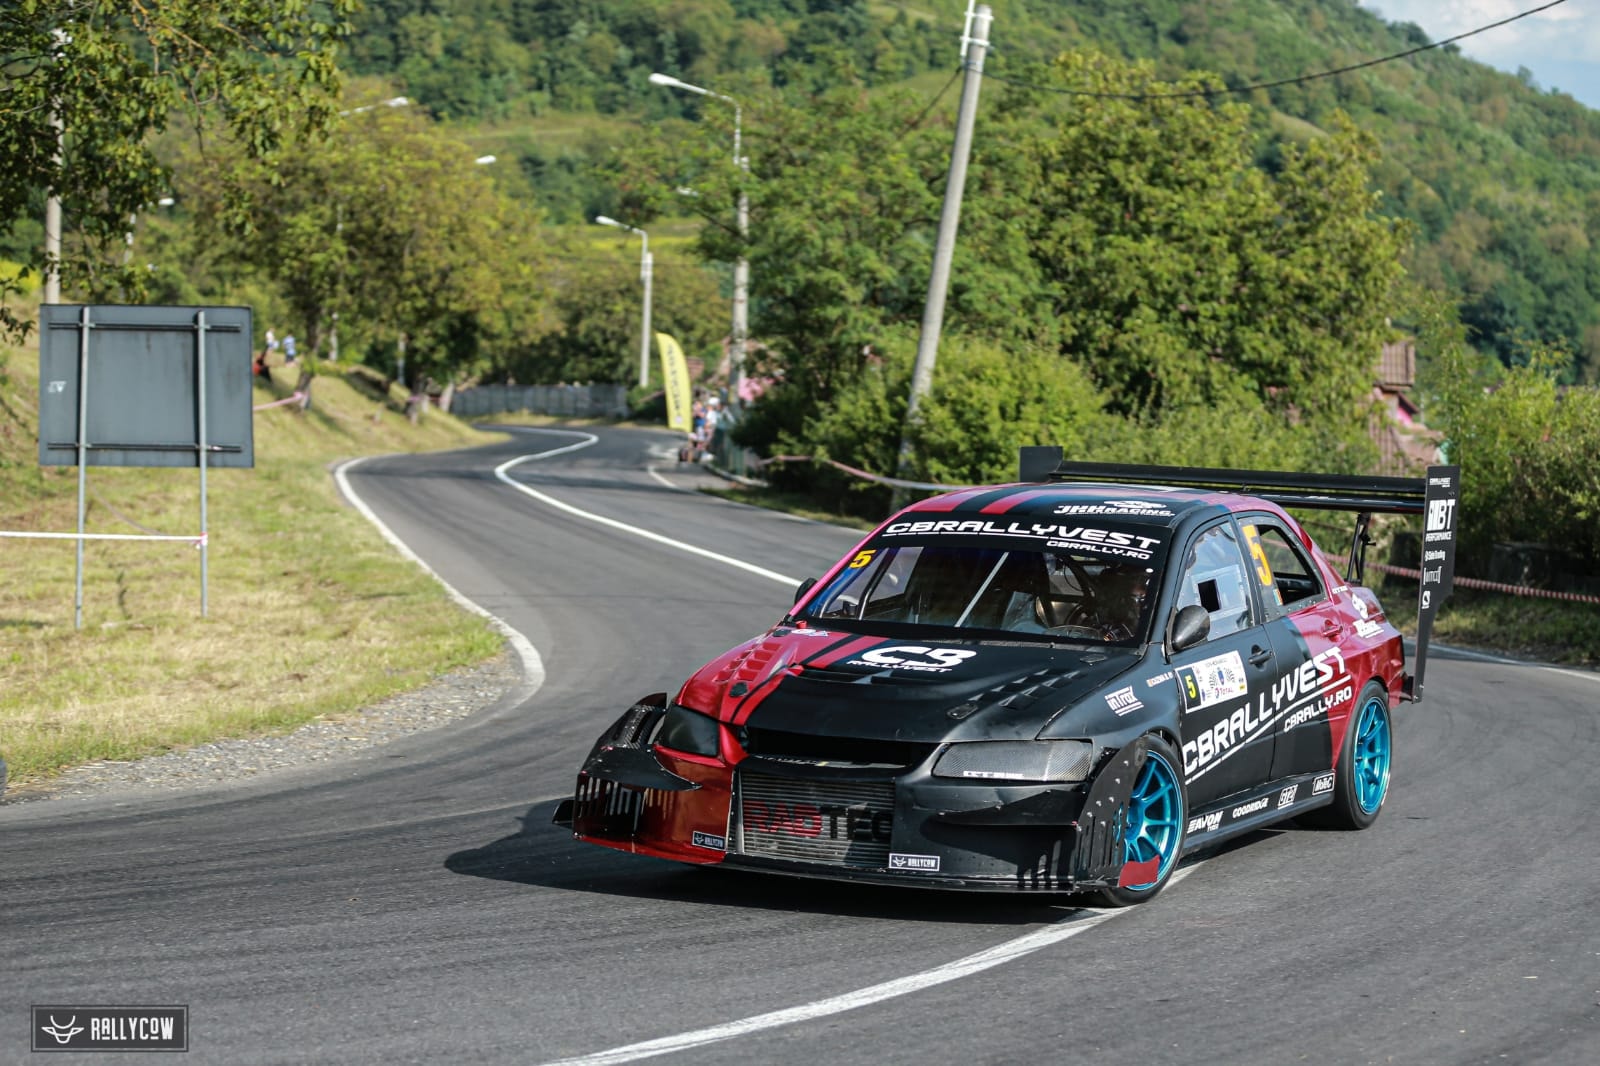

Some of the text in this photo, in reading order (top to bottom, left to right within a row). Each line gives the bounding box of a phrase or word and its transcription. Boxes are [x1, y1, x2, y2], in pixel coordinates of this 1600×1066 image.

[883, 520, 1160, 549] CBRALLYVEST
[849, 549, 876, 568] 5
[1046, 540, 1150, 560] CBRALLY.RO
[1242, 524, 1272, 587] 5
[1184, 674, 1197, 699] 5
[1182, 646, 1346, 776] CBRALLYVEST
[1283, 686, 1352, 733] CBRALLY.RO
[907, 858, 936, 867] RALLYCOW
